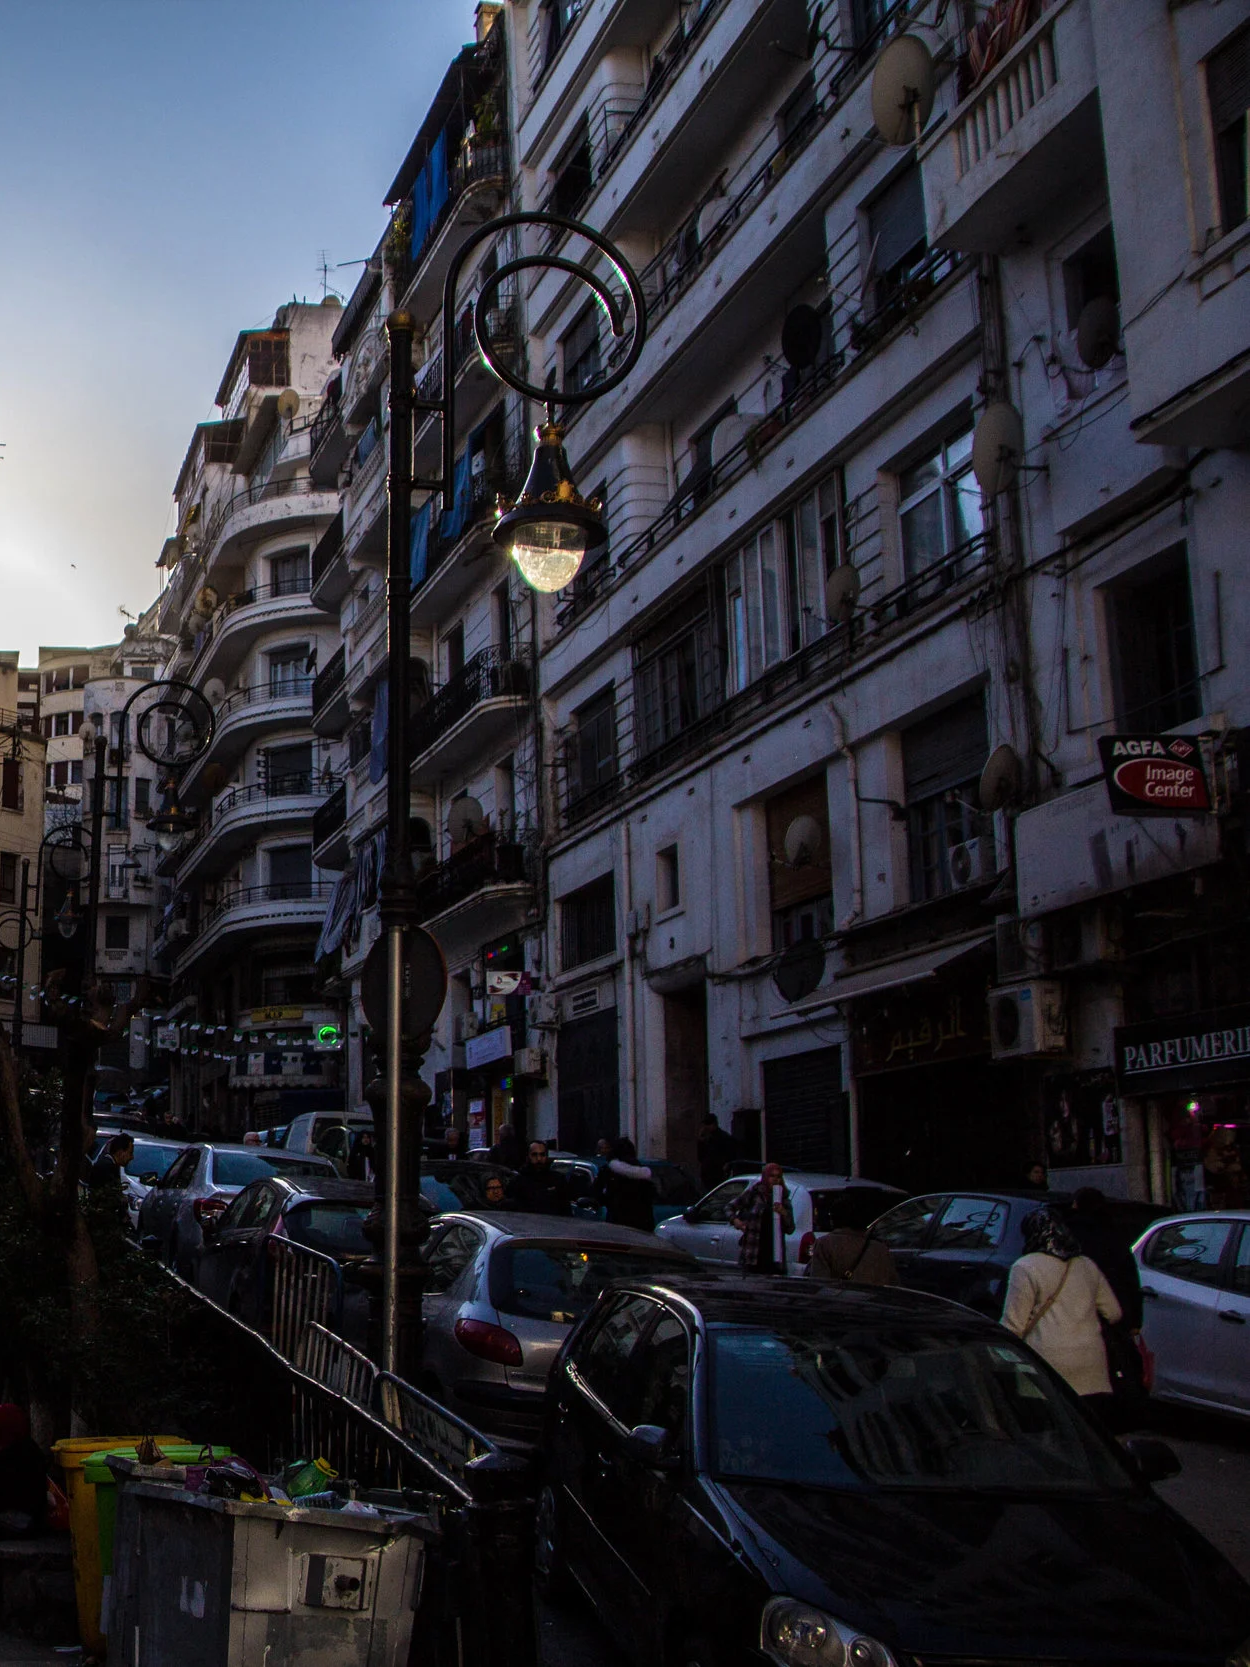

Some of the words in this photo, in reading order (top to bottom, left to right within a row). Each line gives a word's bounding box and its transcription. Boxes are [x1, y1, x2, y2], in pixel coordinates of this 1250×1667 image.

[1112, 740, 1166, 756] AGFA
[1146, 764, 1194, 785] Image
[1145, 782, 1195, 798] Center
